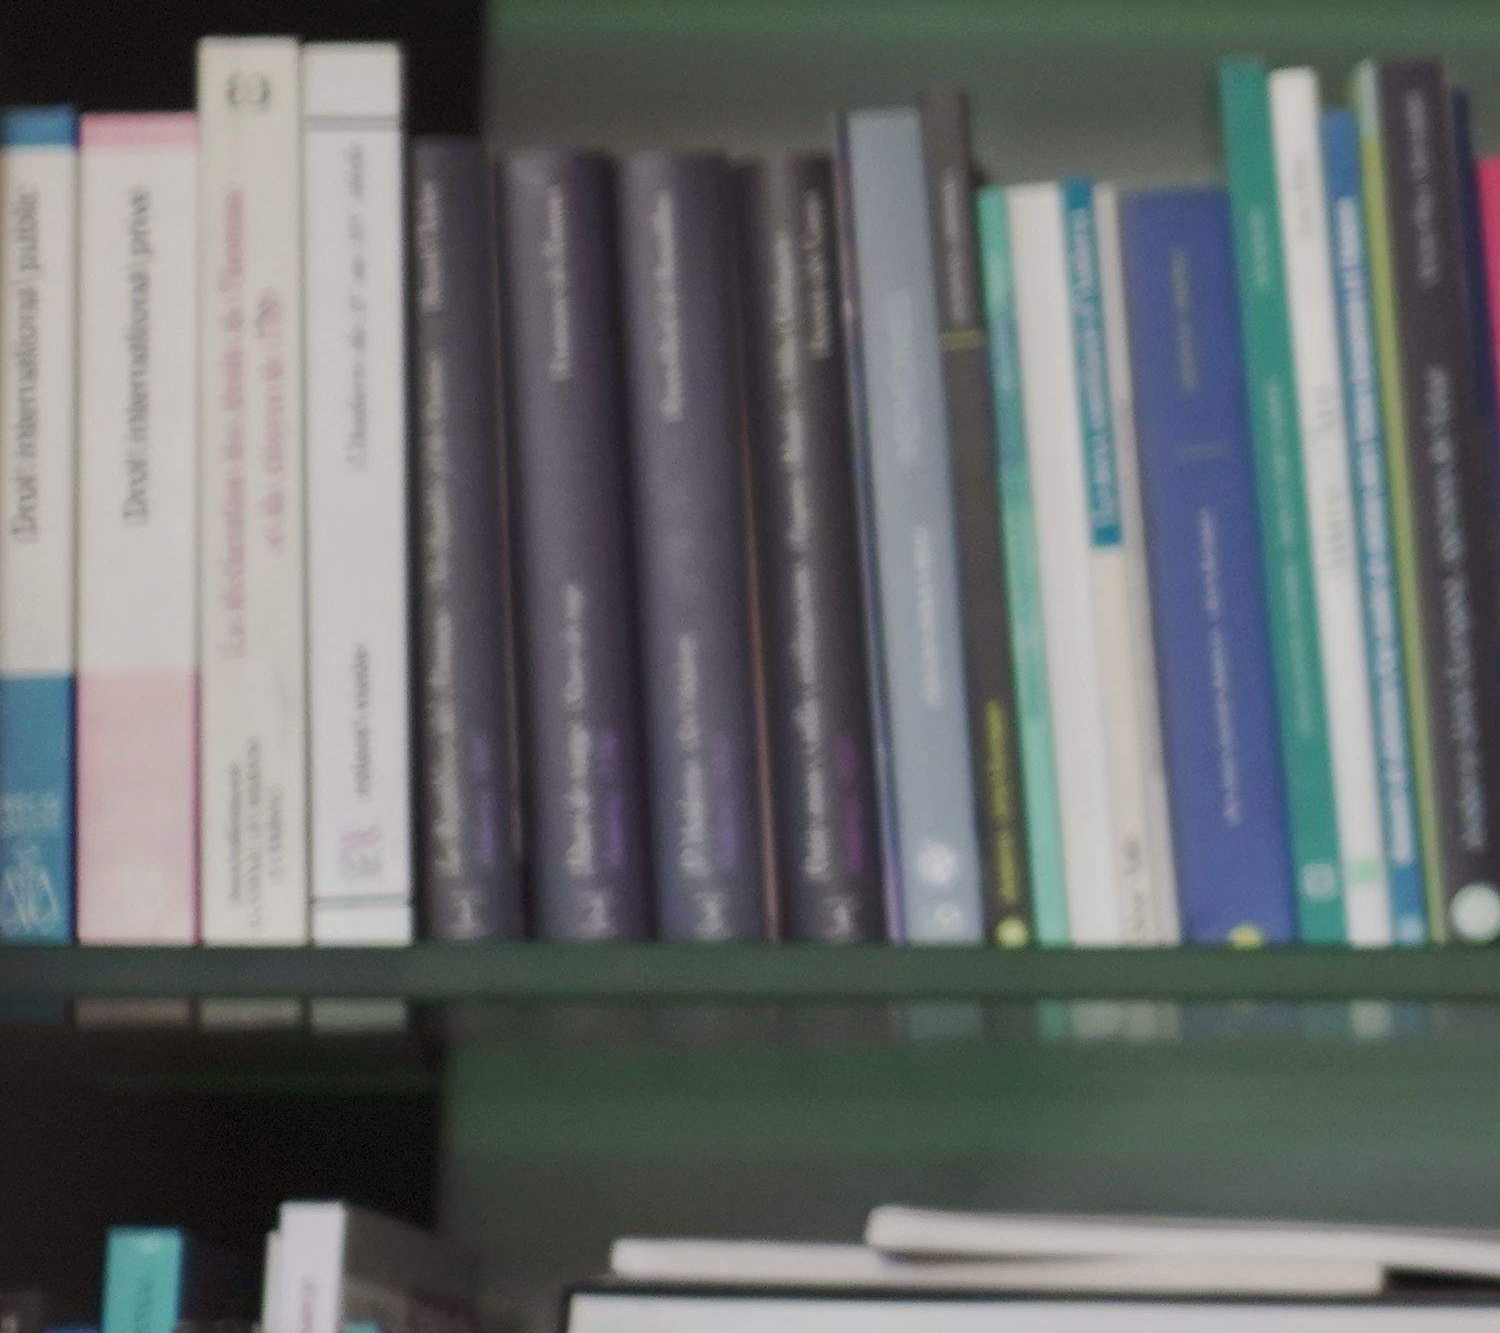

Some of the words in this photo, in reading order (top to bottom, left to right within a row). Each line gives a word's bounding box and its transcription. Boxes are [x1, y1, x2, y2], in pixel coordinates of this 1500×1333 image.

[10, 191, 43, 272] public
[10, 288, 38, 464] international
[121, 270, 150, 444] international
